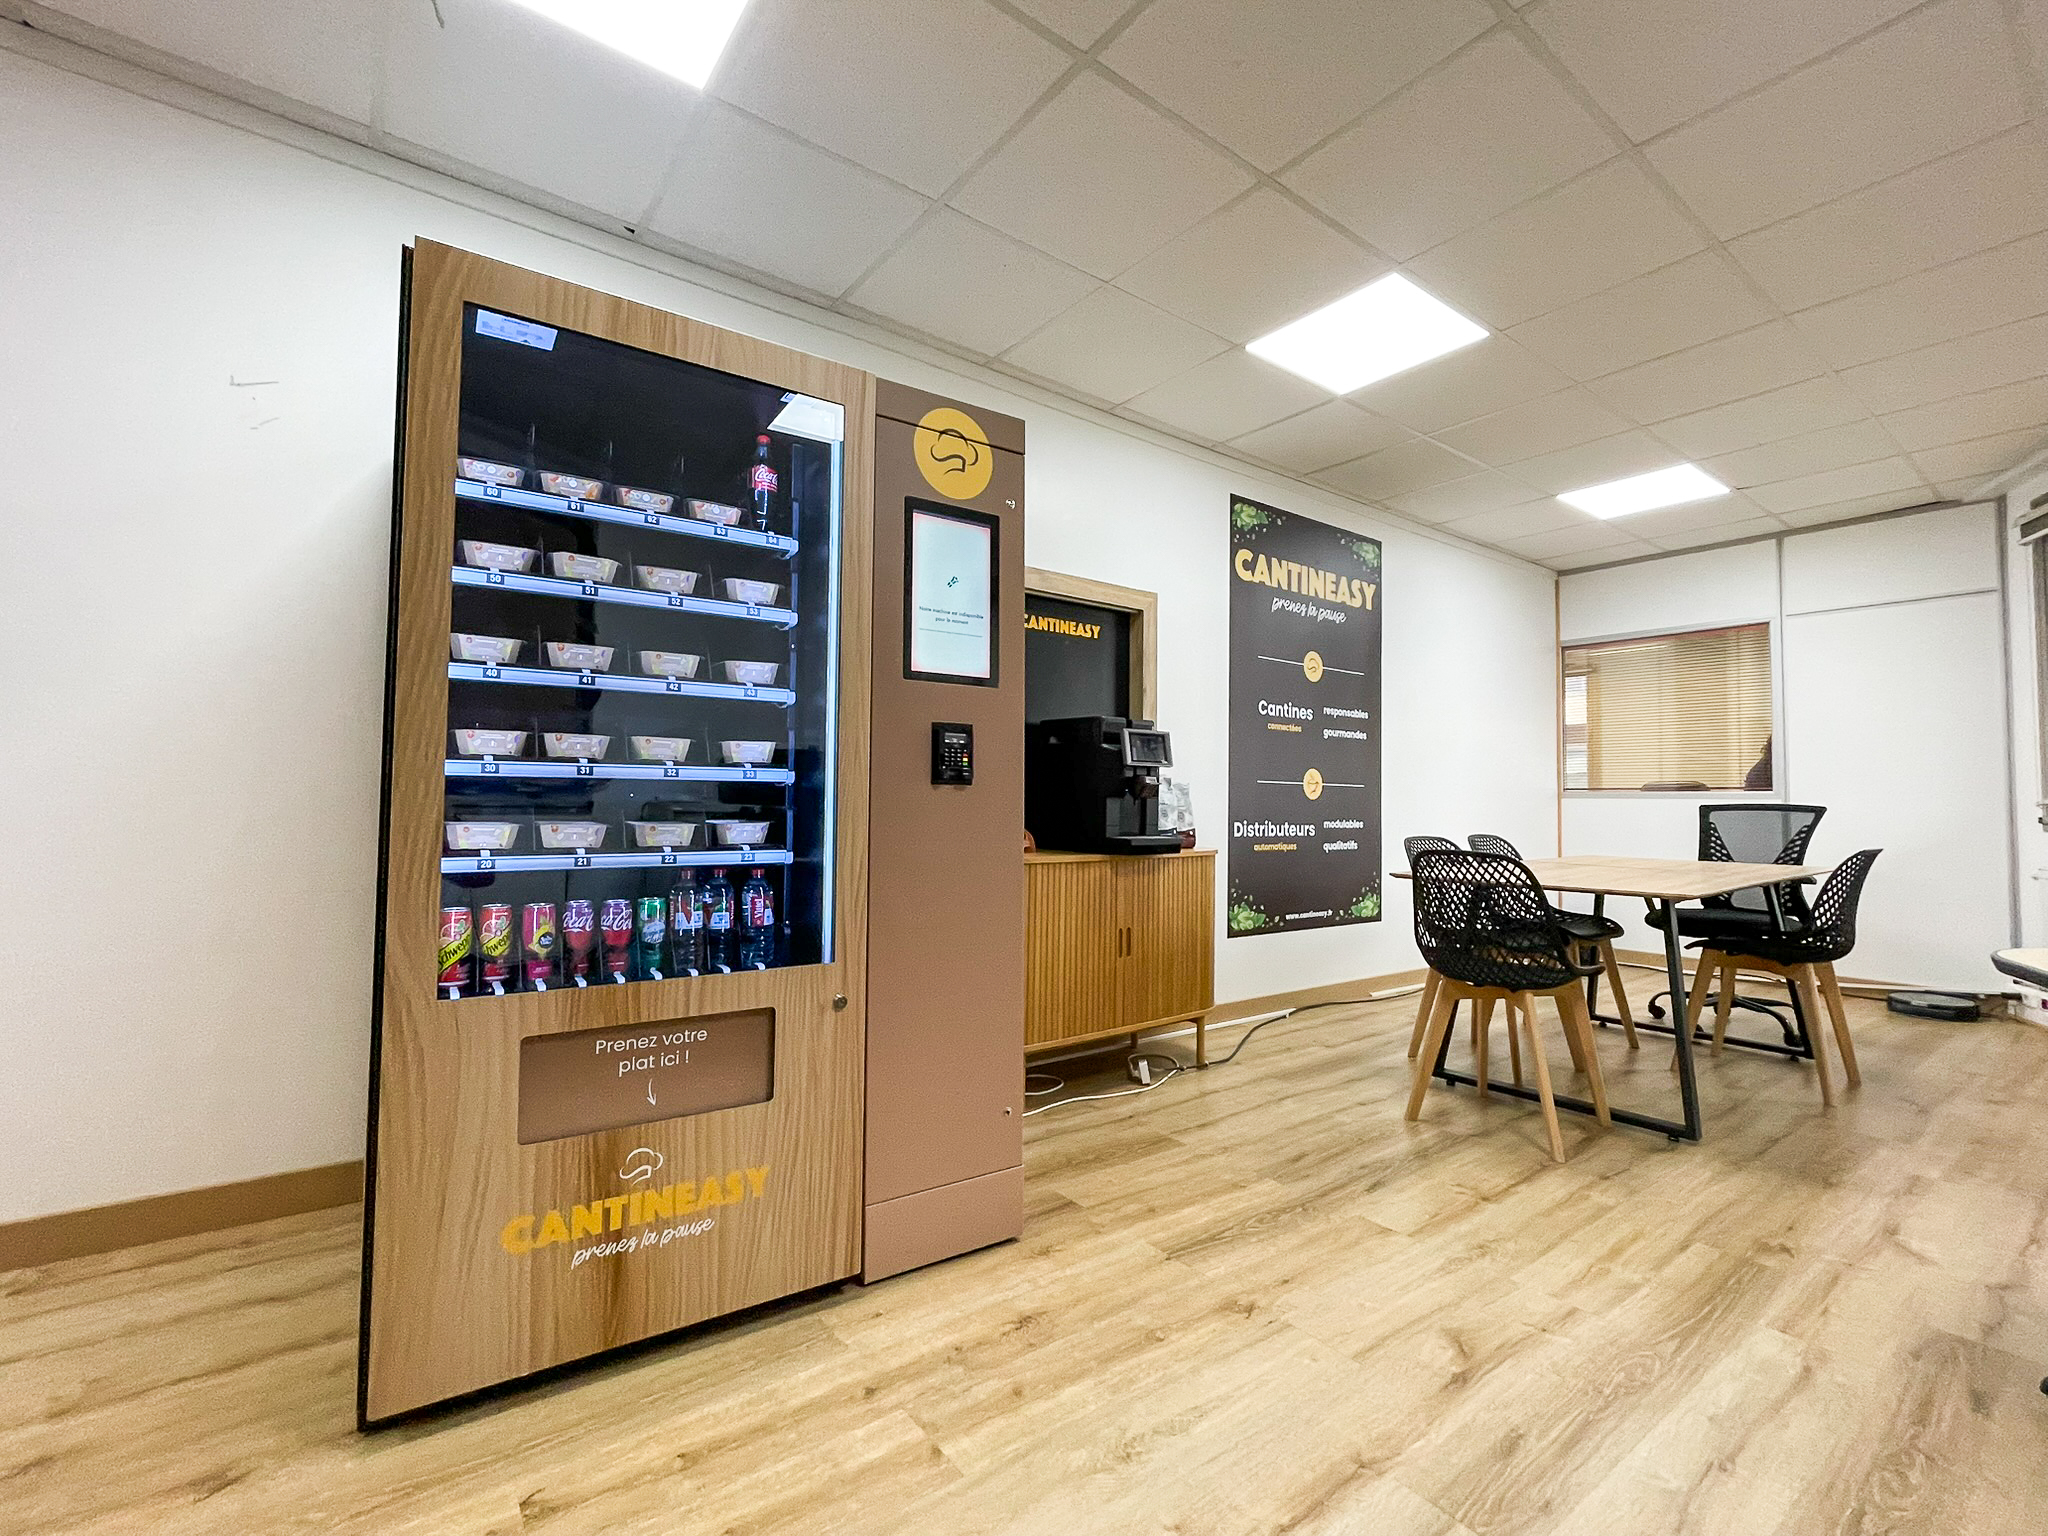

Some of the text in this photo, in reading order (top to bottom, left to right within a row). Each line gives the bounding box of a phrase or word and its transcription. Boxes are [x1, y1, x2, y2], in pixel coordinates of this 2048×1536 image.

[486, 487, 499, 497] 60
[571, 501, 582, 511] 61
[647, 515, 658, 524] 62
[489, 573, 502, 583] 50
[1234, 548, 1377, 611] CANTINEASY
[585, 586, 596, 595] 51
[671, 597, 682, 606] 52
[748, 607, 759, 616] 53
[1271, 596, 1347, 624] prenez la pause
[485, 668, 498, 678] 40
[581, 676, 592, 685] 41
[669, 683, 680, 691] 42
[746, 688, 756, 696] 43
[1258, 699, 1314, 721] Cantines
[1323, 706, 1369, 719] responsables
[1323, 728, 1367, 740] gourmandes
[484, 763, 497, 773] 30
[580, 766, 591, 775] 31
[666, 768, 677, 777] 32
[746, 770, 756, 778] 33
[1233, 820, 1316, 837] Distributeurs
[1323, 819, 1364, 829] modulables
[1253, 841, 1297, 852] automatiques
[1323, 840, 1358, 853] qualitatifs
[577, 857, 588, 866] 21
[664, 855, 675, 863] 22
[744, 853, 754, 861] 23
[480, 859, 492, 868] 20
[595, 1028, 708, 1054] Prenez votre
[618, 1050, 690, 1077] plat ici !
[502, 1164, 772, 1256] CANTINEASY
[570, 1217, 715, 1270] prenez la pause
